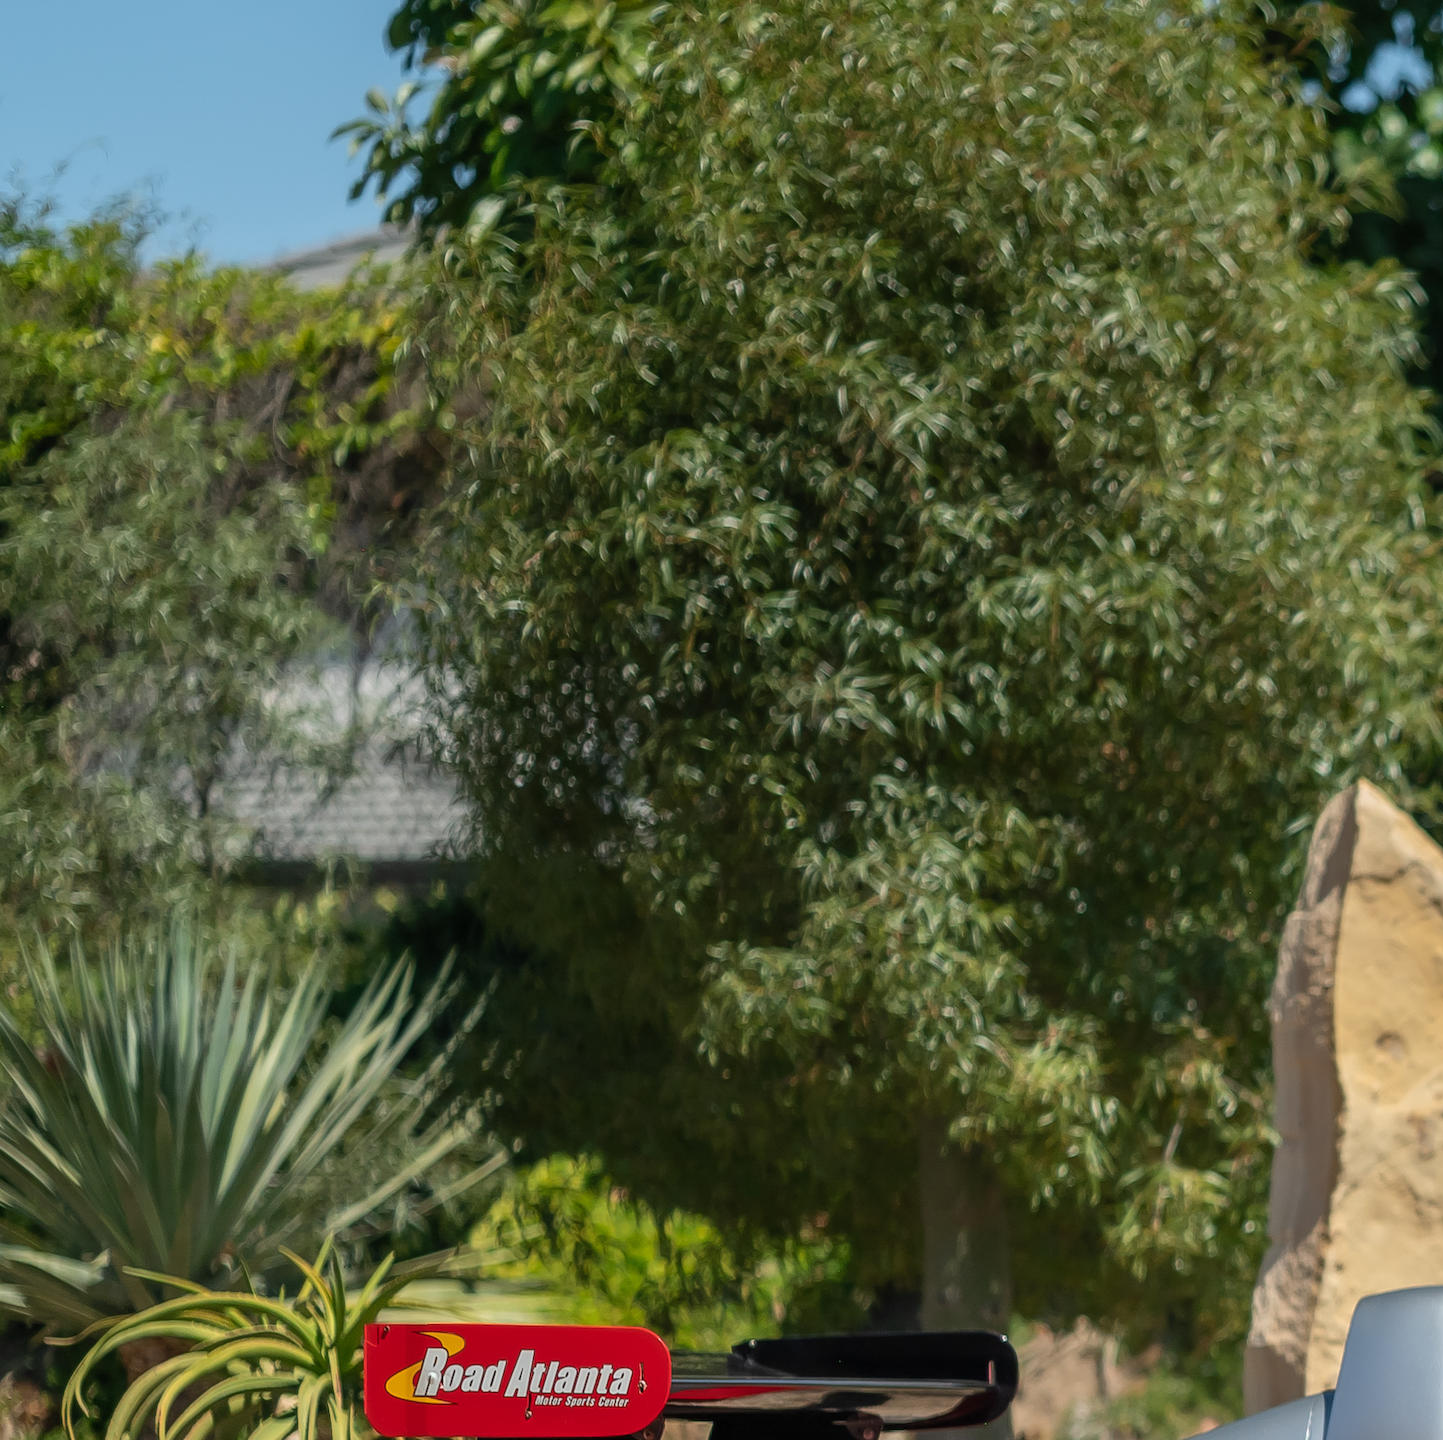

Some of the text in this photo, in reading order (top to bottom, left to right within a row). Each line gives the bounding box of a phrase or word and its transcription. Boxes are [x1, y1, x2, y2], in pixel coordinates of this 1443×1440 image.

[413, 1347, 634, 1398] Road Atlanta
[534, 1394, 629, 1408] Motor Sports Center
